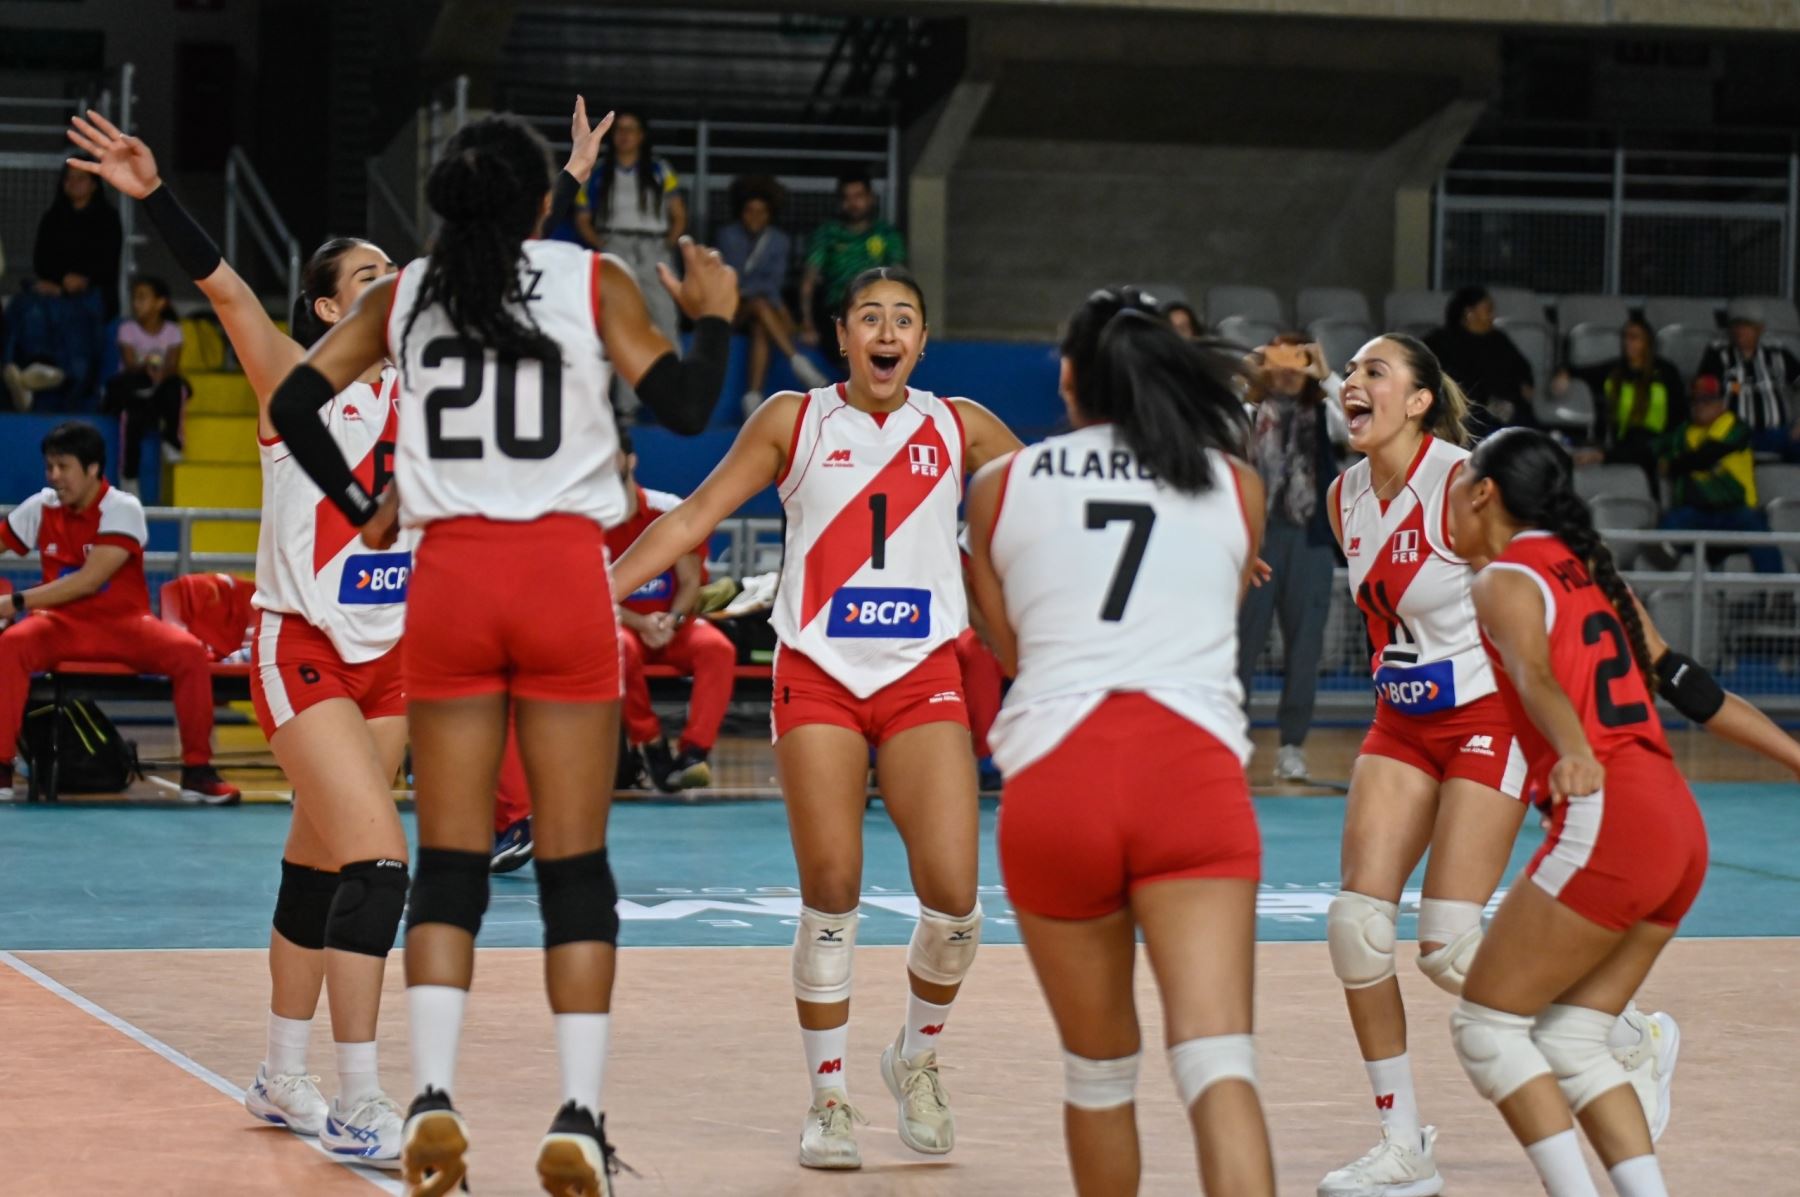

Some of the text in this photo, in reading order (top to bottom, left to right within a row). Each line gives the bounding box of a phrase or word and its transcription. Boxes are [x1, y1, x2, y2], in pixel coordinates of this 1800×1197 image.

[422, 335, 562, 460] 20
[911, 464, 938, 478] PER
[869, 493, 887, 570] 1
[1085, 499, 1157, 622] 7
[1392, 551, 1419, 564] PER
[370, 566, 409, 591] BCP
[859, 601, 911, 625] BCP
[1359, 580, 1415, 644] 11
[298, 663, 321, 685] 6
[1582, 611, 1649, 728] 2
[1390, 681, 1425, 704] BCP
